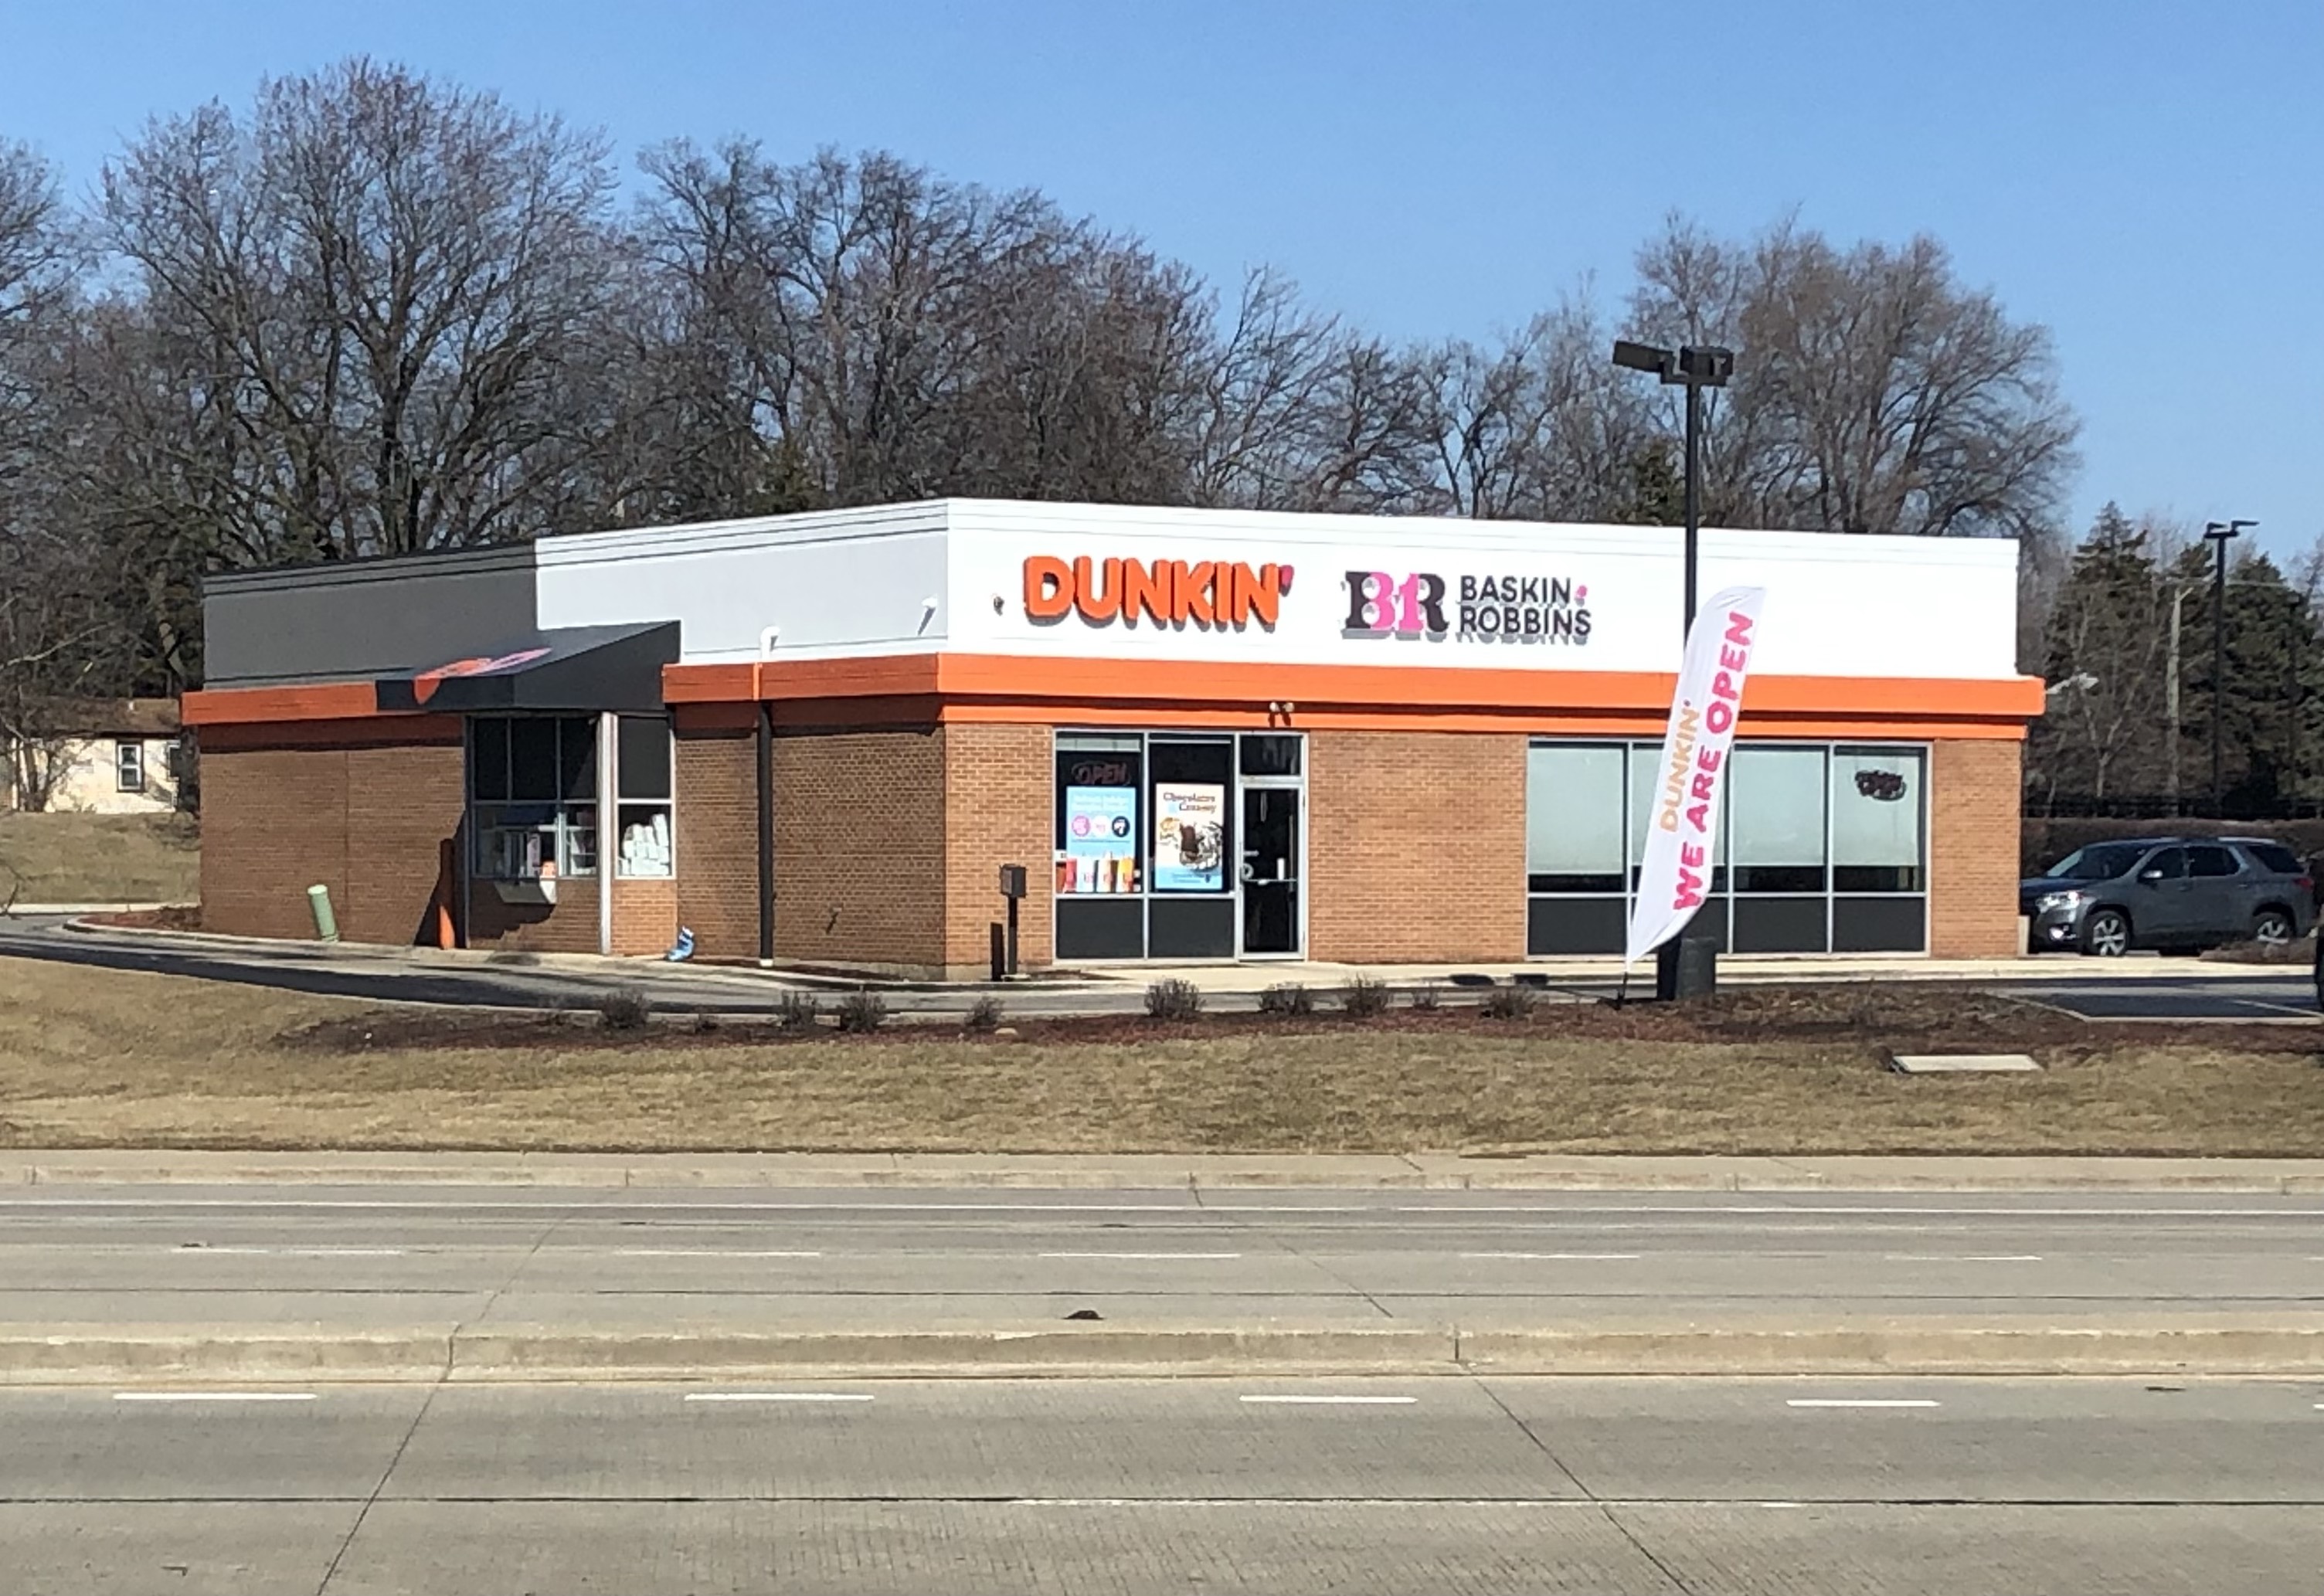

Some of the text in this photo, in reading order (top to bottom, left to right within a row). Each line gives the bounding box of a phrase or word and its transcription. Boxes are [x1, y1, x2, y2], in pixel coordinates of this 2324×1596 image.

[1024, 555, 1294, 627] DUNKIN'
[1460, 606, 1592, 636] ROBBINS
[1673, 612, 1753, 910] WE ARE OPEN
